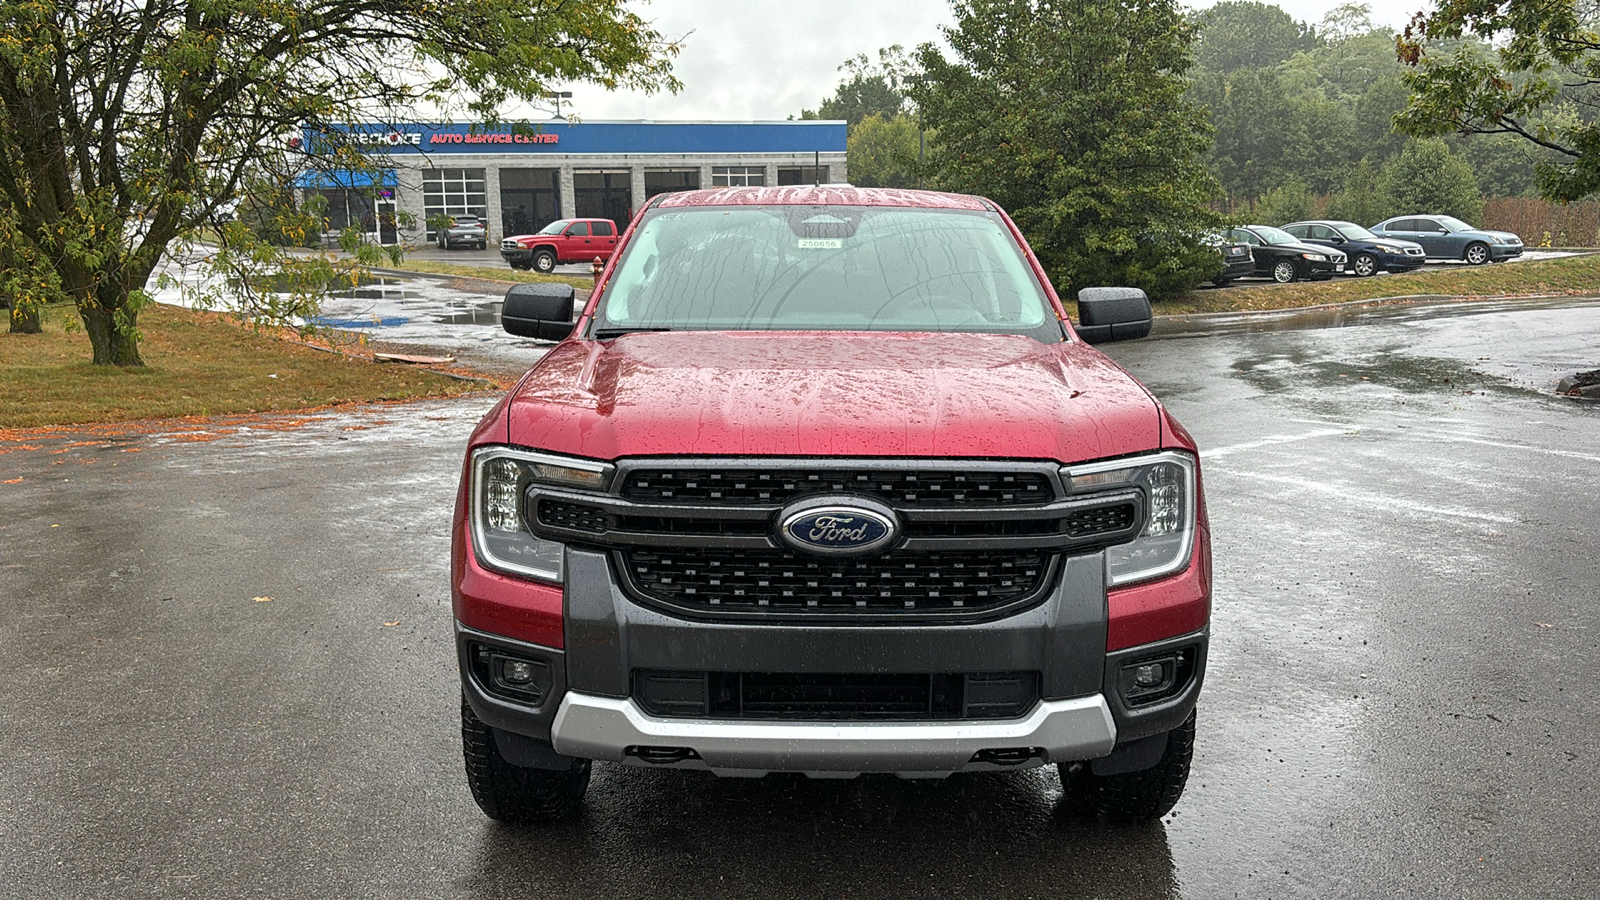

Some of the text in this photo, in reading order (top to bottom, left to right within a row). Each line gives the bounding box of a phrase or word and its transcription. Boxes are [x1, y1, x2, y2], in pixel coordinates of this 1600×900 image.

[429, 133, 463, 143] AUTO
[464, 133, 512, 143] SERVICE
[809, 516, 868, 542] Ford
